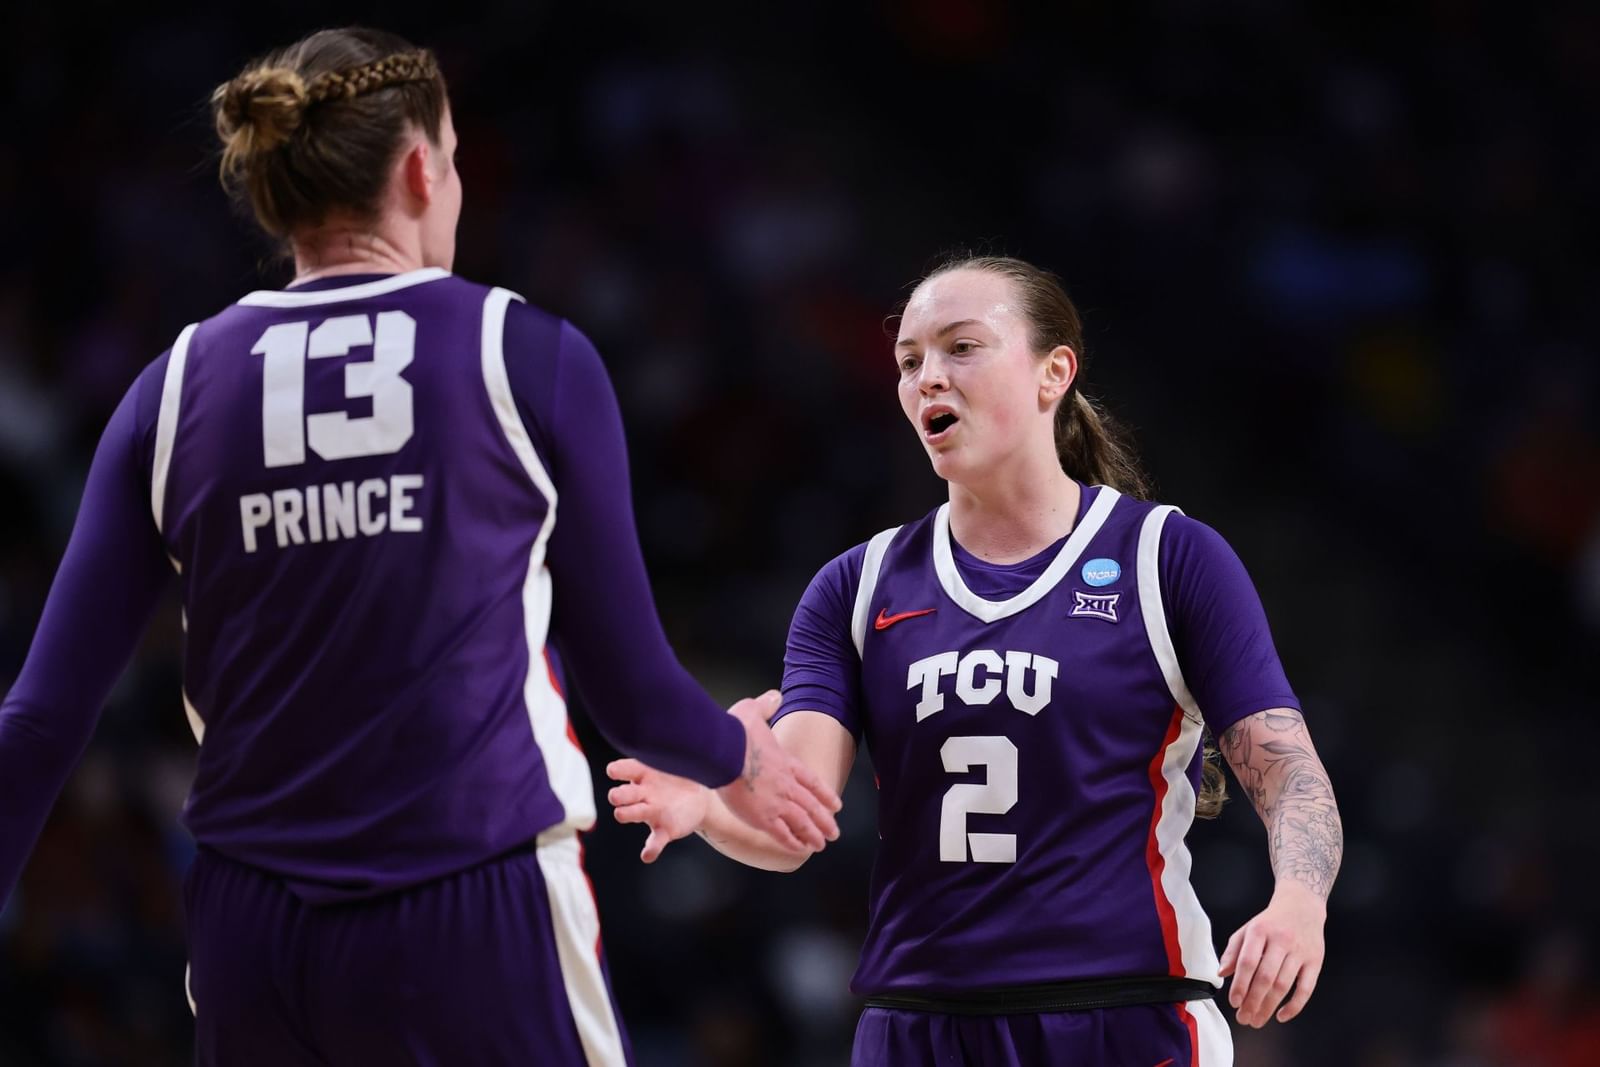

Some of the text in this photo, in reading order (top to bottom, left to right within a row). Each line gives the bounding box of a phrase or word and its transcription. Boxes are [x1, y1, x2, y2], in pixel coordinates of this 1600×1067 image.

[250, 310, 416, 468] 13
[239, 474, 424, 553] PRINCE
[907, 650, 1059, 723] TCU
[939, 736, 1018, 863] 2
